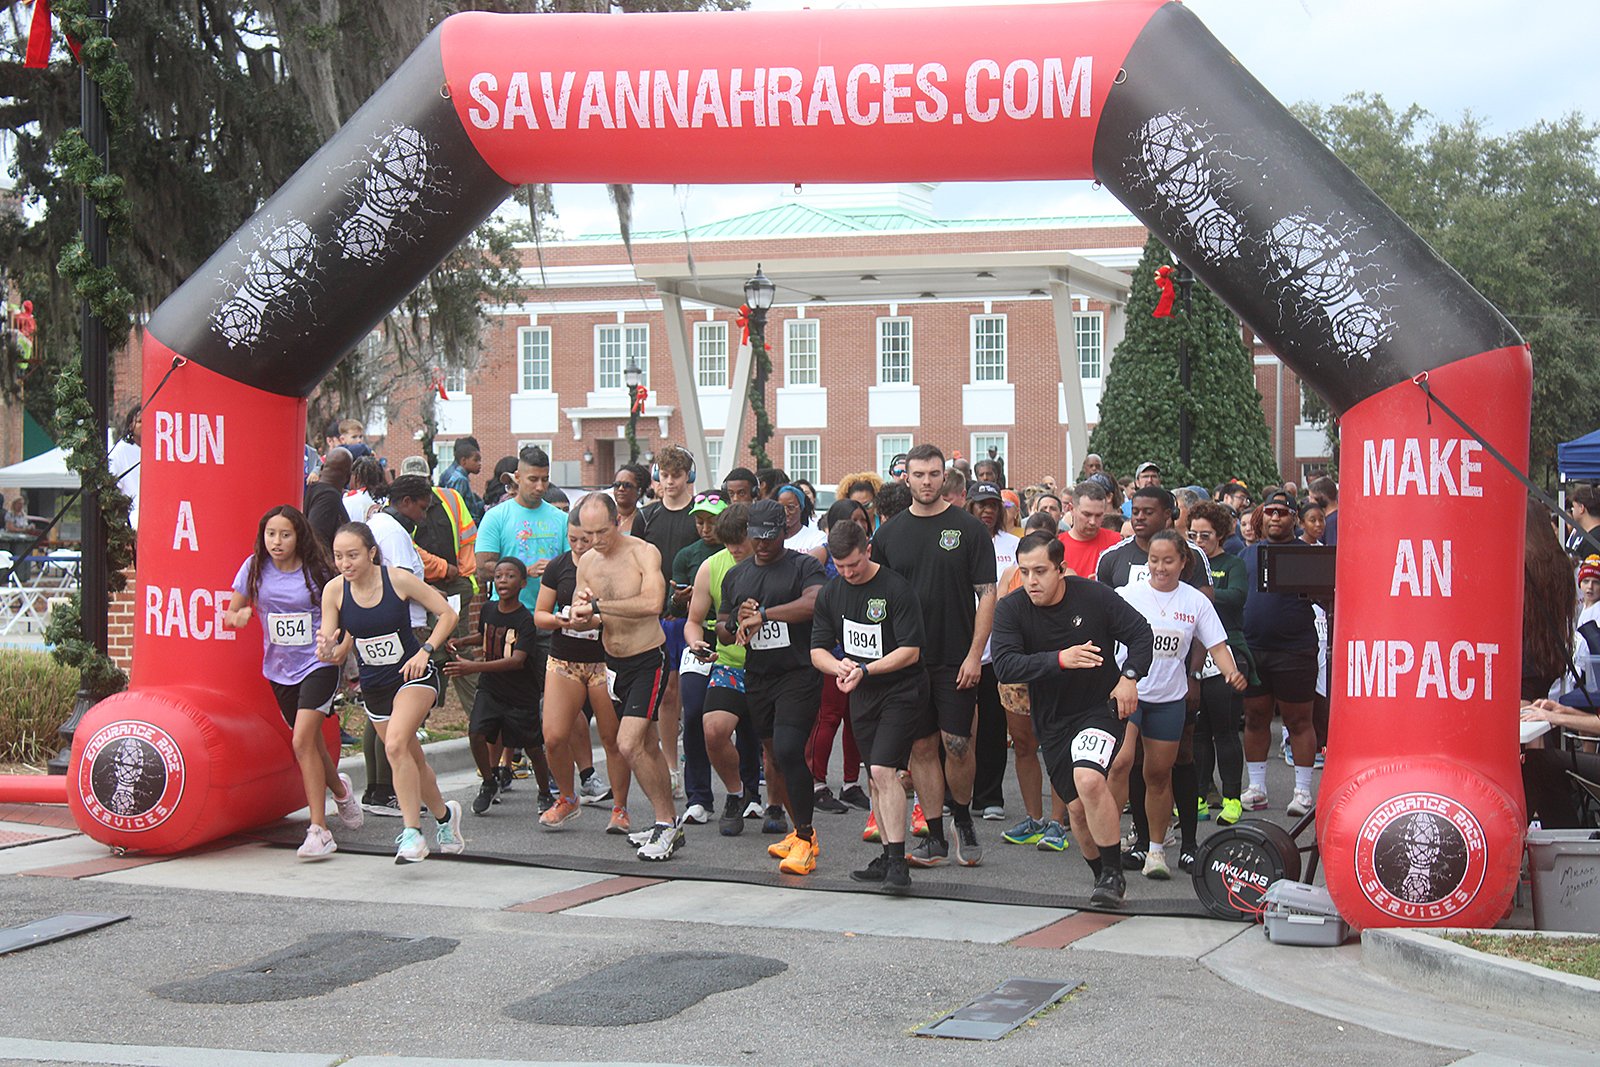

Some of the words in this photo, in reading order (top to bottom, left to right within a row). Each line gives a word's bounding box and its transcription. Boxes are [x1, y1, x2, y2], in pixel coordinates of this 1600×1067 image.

[467, 56, 1093, 131] SAVANNAHRACES.COM
[155, 411, 225, 465] RUN
[1363, 438, 1483, 497] MAKE
[172, 501, 199, 551] A
[1390, 539, 1452, 597] AN
[145, 585, 236, 641] RACE
[276, 619, 306, 637] 654
[848, 629, 877, 649] 1894
[1173, 611, 1195, 624] 31313
[365, 641, 397, 659] 652
[1347, 640, 1499, 700] IMPACT
[85, 724, 156, 762] ENDURANCE
[156, 737, 181, 773] RACE
[1077, 734, 1107, 755] 391
[1363, 797, 1451, 842] ENDURANCE
[1453, 810, 1482, 851] RACE
